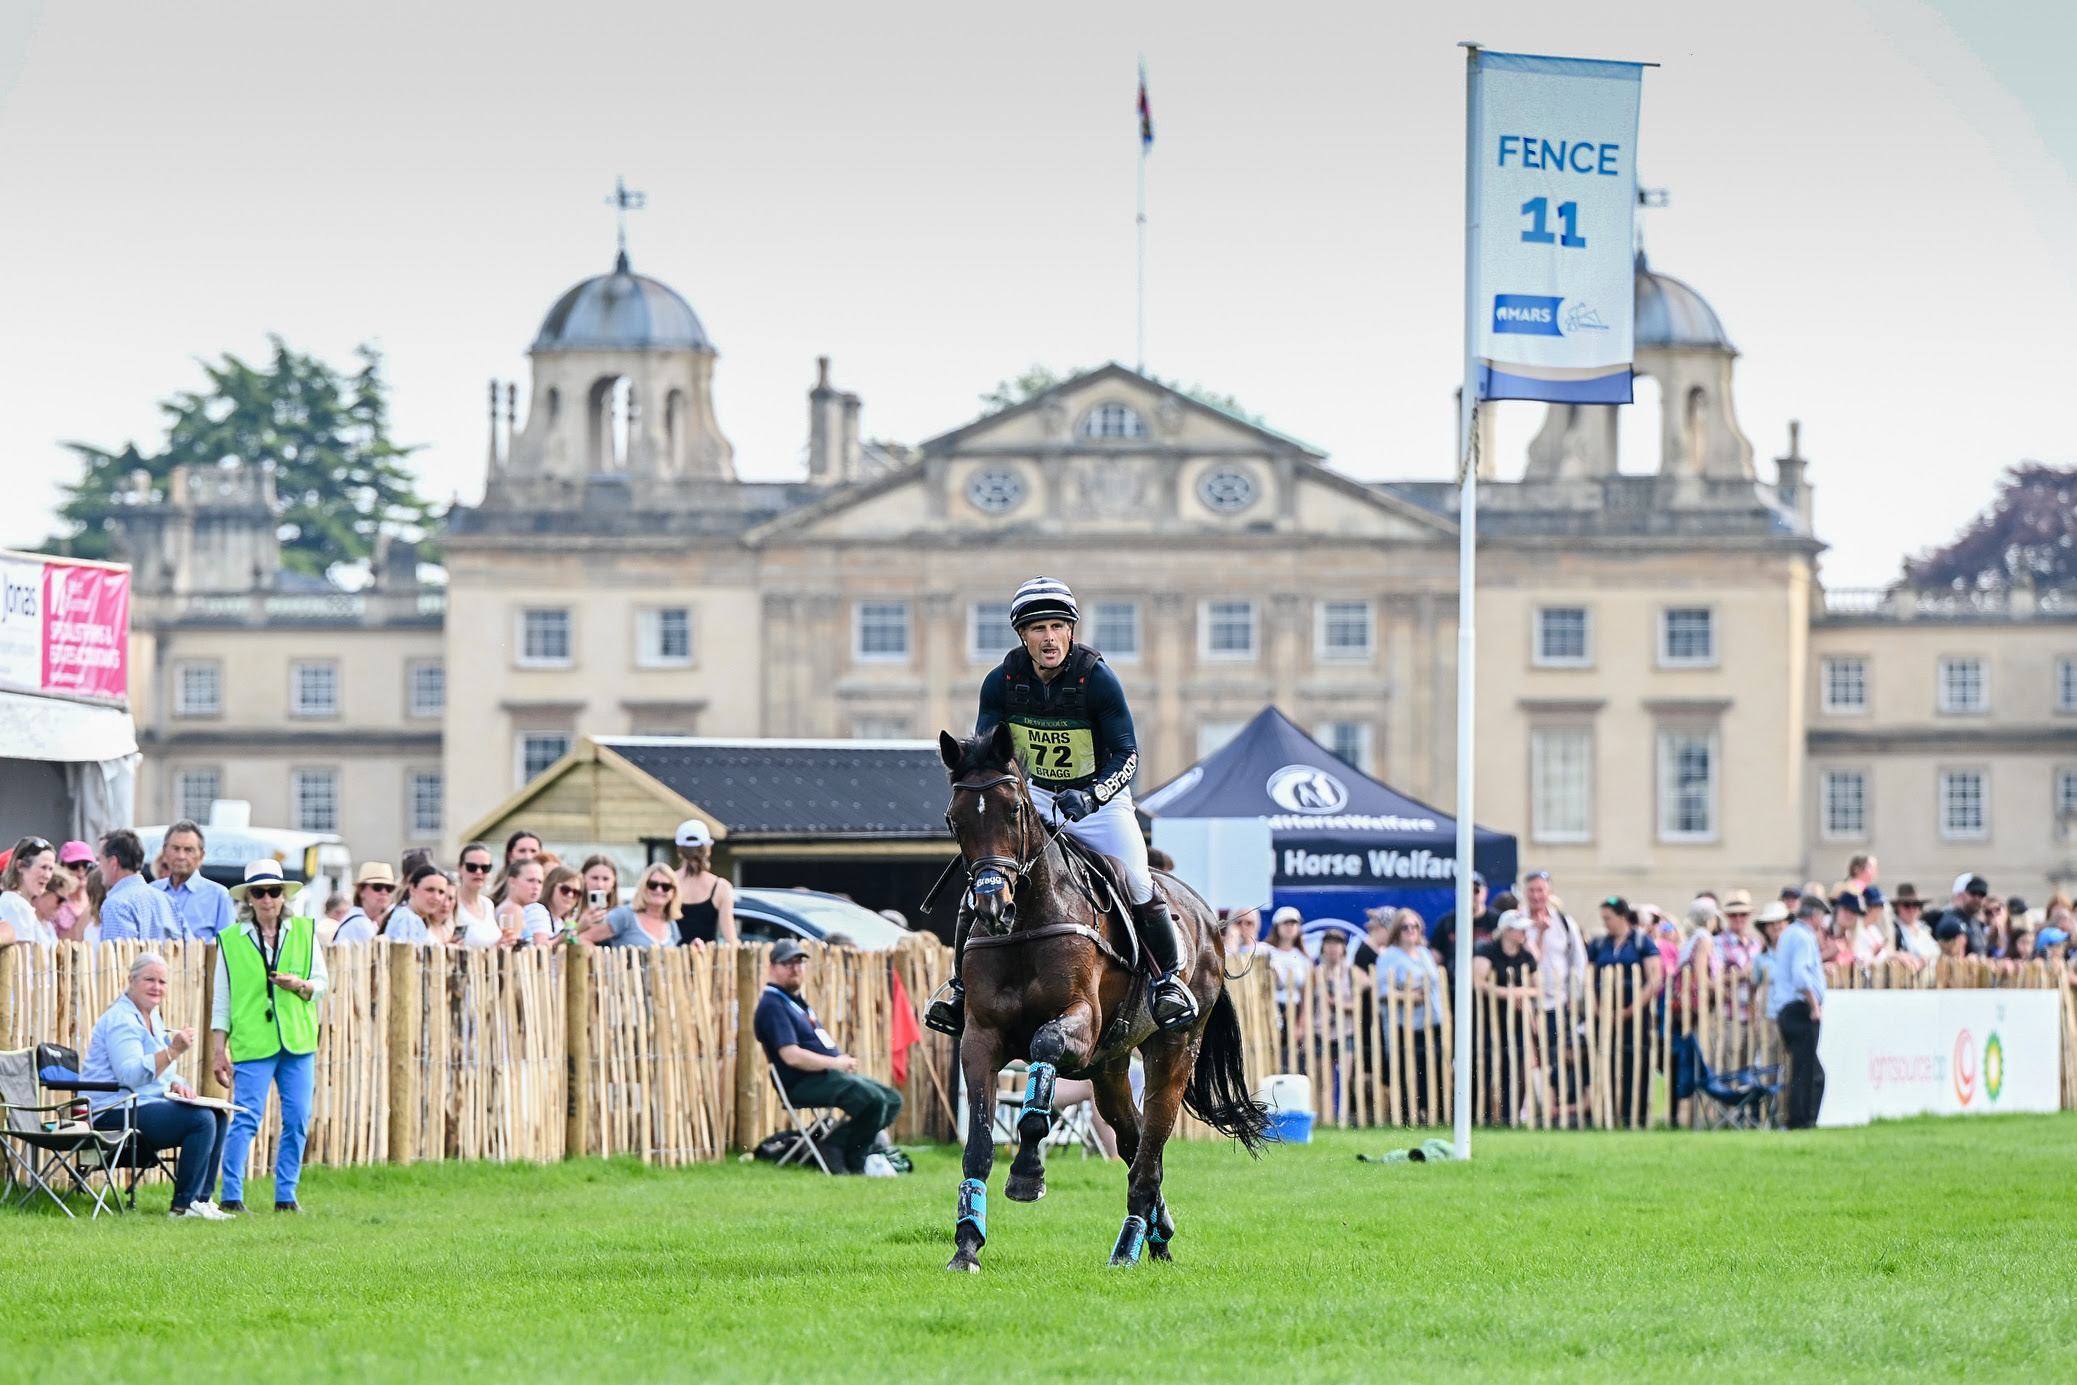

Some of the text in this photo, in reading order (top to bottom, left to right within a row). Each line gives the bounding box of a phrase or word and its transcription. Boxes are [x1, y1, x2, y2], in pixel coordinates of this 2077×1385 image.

[1498, 135, 1620, 176] FENCE
[1520, 196, 1587, 248] 11
[1507, 306, 1552, 323] MARS
[1028, 729, 1071, 744] MARS
[1030, 743, 1073, 768] 72
[1036, 766, 1071, 778] BRAGG
[1103, 757, 1137, 796] Bragg
[1284, 849, 1363, 877] Horse
[976, 876, 1002, 888] Bragg
